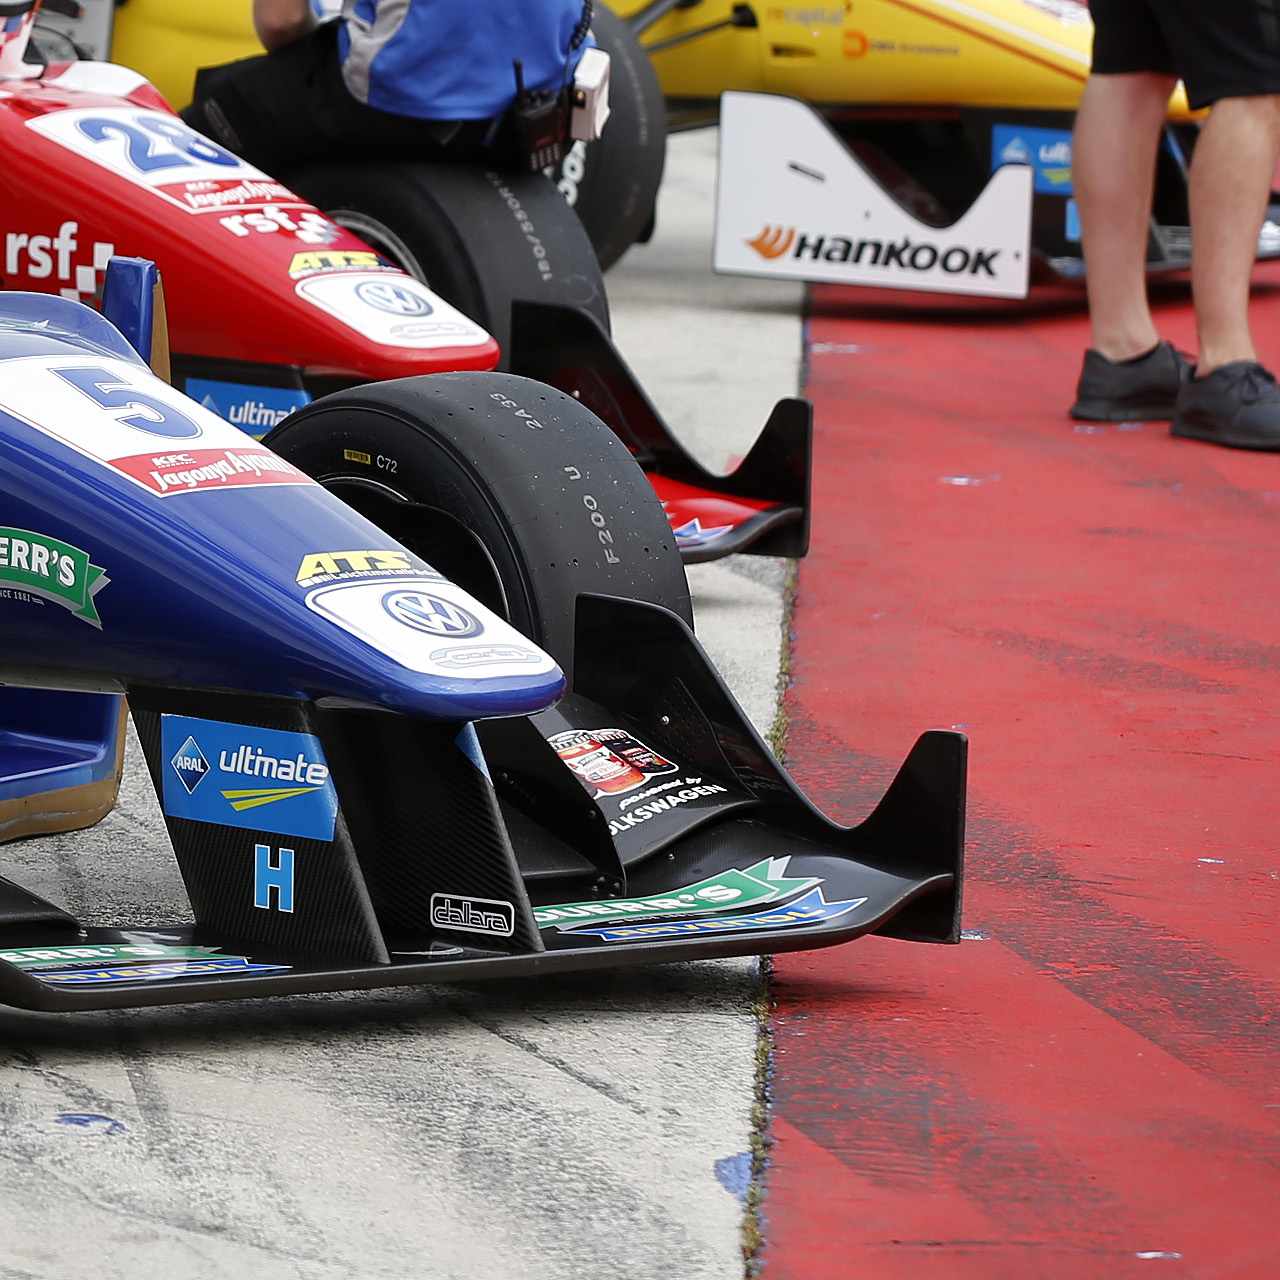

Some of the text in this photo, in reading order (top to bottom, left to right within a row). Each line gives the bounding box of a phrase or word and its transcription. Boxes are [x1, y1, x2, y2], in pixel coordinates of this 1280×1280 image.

[219, 206, 300, 237] rsf
[5, 220, 80, 281] rsf
[287, 250, 381, 275] ATS
[46, 365, 204, 440] 5
[228, 400, 297, 428] ultima
[148, 457, 233, 492] Jagonya
[151, 452, 195, 467] KFC
[374, 453, 400, 474] C72
[582, 493, 621, 565] F200
[295, 550, 412, 582] ATS
[175, 744, 331, 786] ARAL ultimate
[608, 784, 728, 837] LKSWAGEN
[618, 777, 684, 811] powered
[254, 843, 295, 914] H
[433, 899, 510, 932] dallara
[602, 904, 826, 940] RAVENOL
